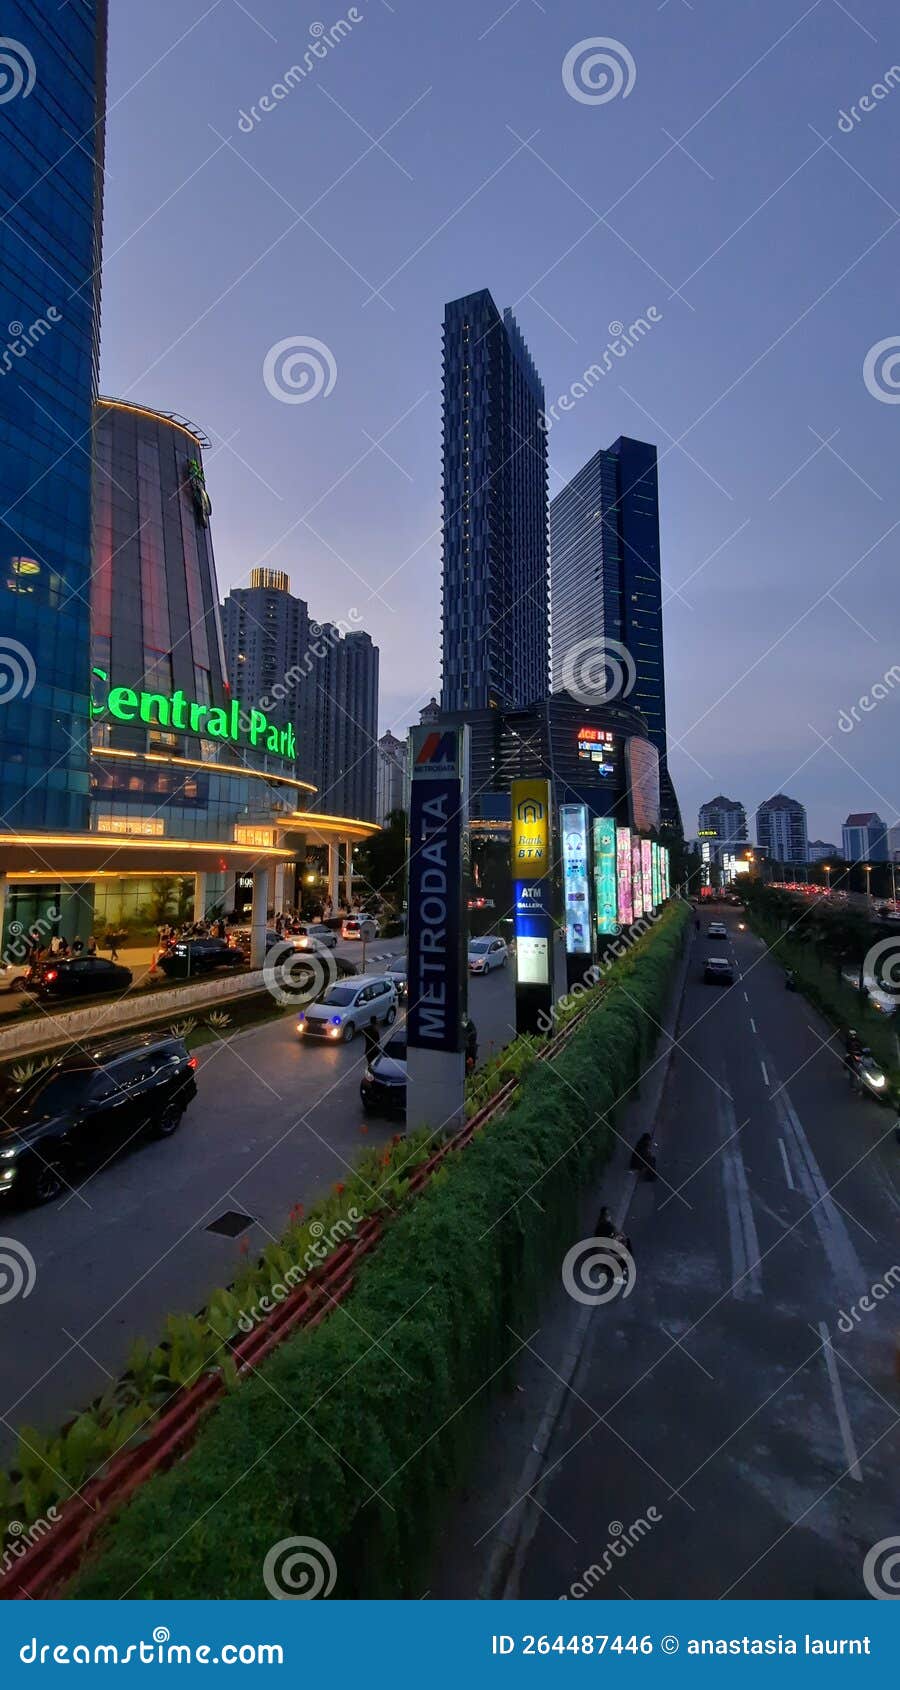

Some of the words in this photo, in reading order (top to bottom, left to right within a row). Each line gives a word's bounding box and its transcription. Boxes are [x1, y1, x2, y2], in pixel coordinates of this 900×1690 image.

[90, 667, 240, 741] Central
[250, 709, 296, 760] Park
[578, 728, 597, 740] ACE
[518, 833, 542, 845] Bank
[518, 849, 543, 858] BTN
[521, 887, 541, 898] ATM
[419, 793, 448, 1039] METRODATA
